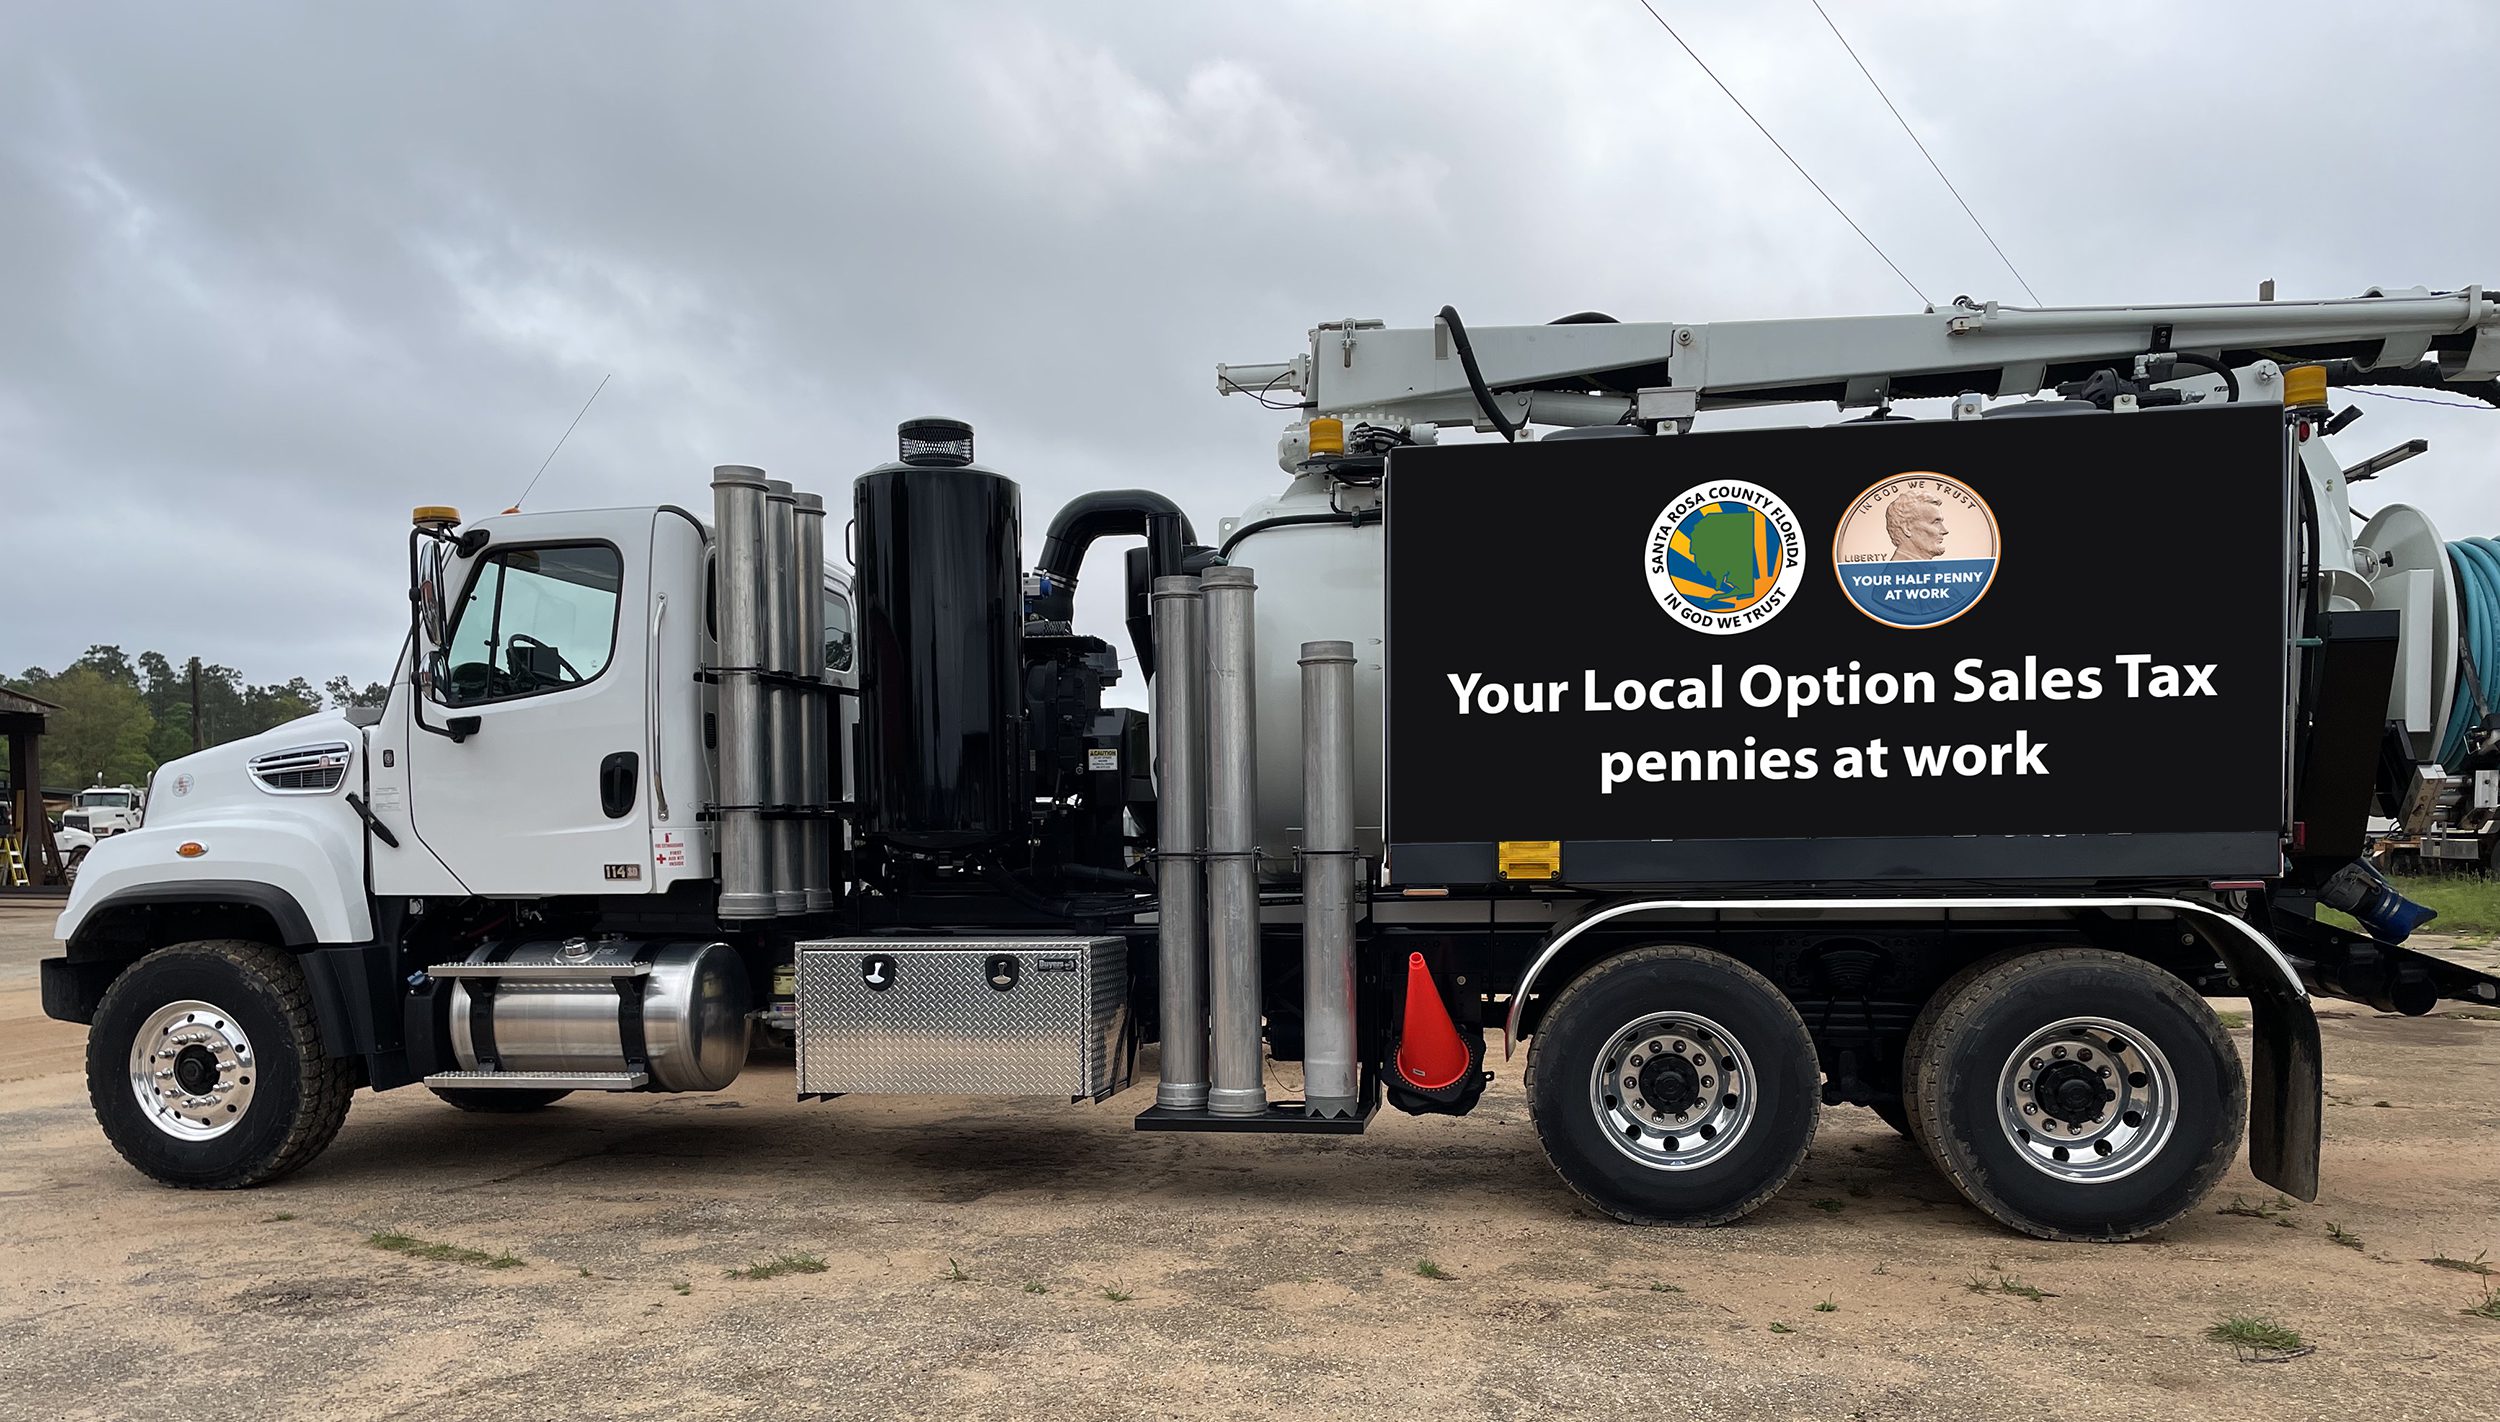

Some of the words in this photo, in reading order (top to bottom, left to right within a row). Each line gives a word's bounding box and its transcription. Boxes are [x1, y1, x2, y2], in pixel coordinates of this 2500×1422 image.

[1859, 503, 1873, 515] IN
[1873, 485, 1899, 502] GOD
[1907, 480, 1926, 489] WE
[1936, 482, 1977, 510] TRUST
[1652, 525, 1672, 574] SANTA
[1667, 493, 1705, 523] ROSA
[1708, 486, 1773, 510] COUNTY
[1770, 507, 1799, 569] FLORIDA
[1844, 553, 1888, 563] LIBERTY
[1852, 575, 1892, 587] YOUR
[1895, 574, 1931, 585] HALF
[1934, 571, 1984, 584] PENNY
[1884, 589, 1903, 601] AT
[1905, 588, 1950, 600] WORK
[1664, 592, 1682, 611] IN
[1681, 607, 1713, 628] GOD
[1717, 615, 1742, 629] WE
[1743, 586, 1787, 624] TRUST
[1447, 672, 1568, 714] Your
[1585, 665, 1722, 711] Local
[1740, 661, 1934, 717] Option
[1954, 656, 2102, 702] Sales
[2116, 654, 2217, 697] Tax
[1602, 736, 1818, 794] pennies
[1834, 739, 1888, 778] at
[1903, 730, 2049, 776] work
[606, 865, 626, 878] 114
